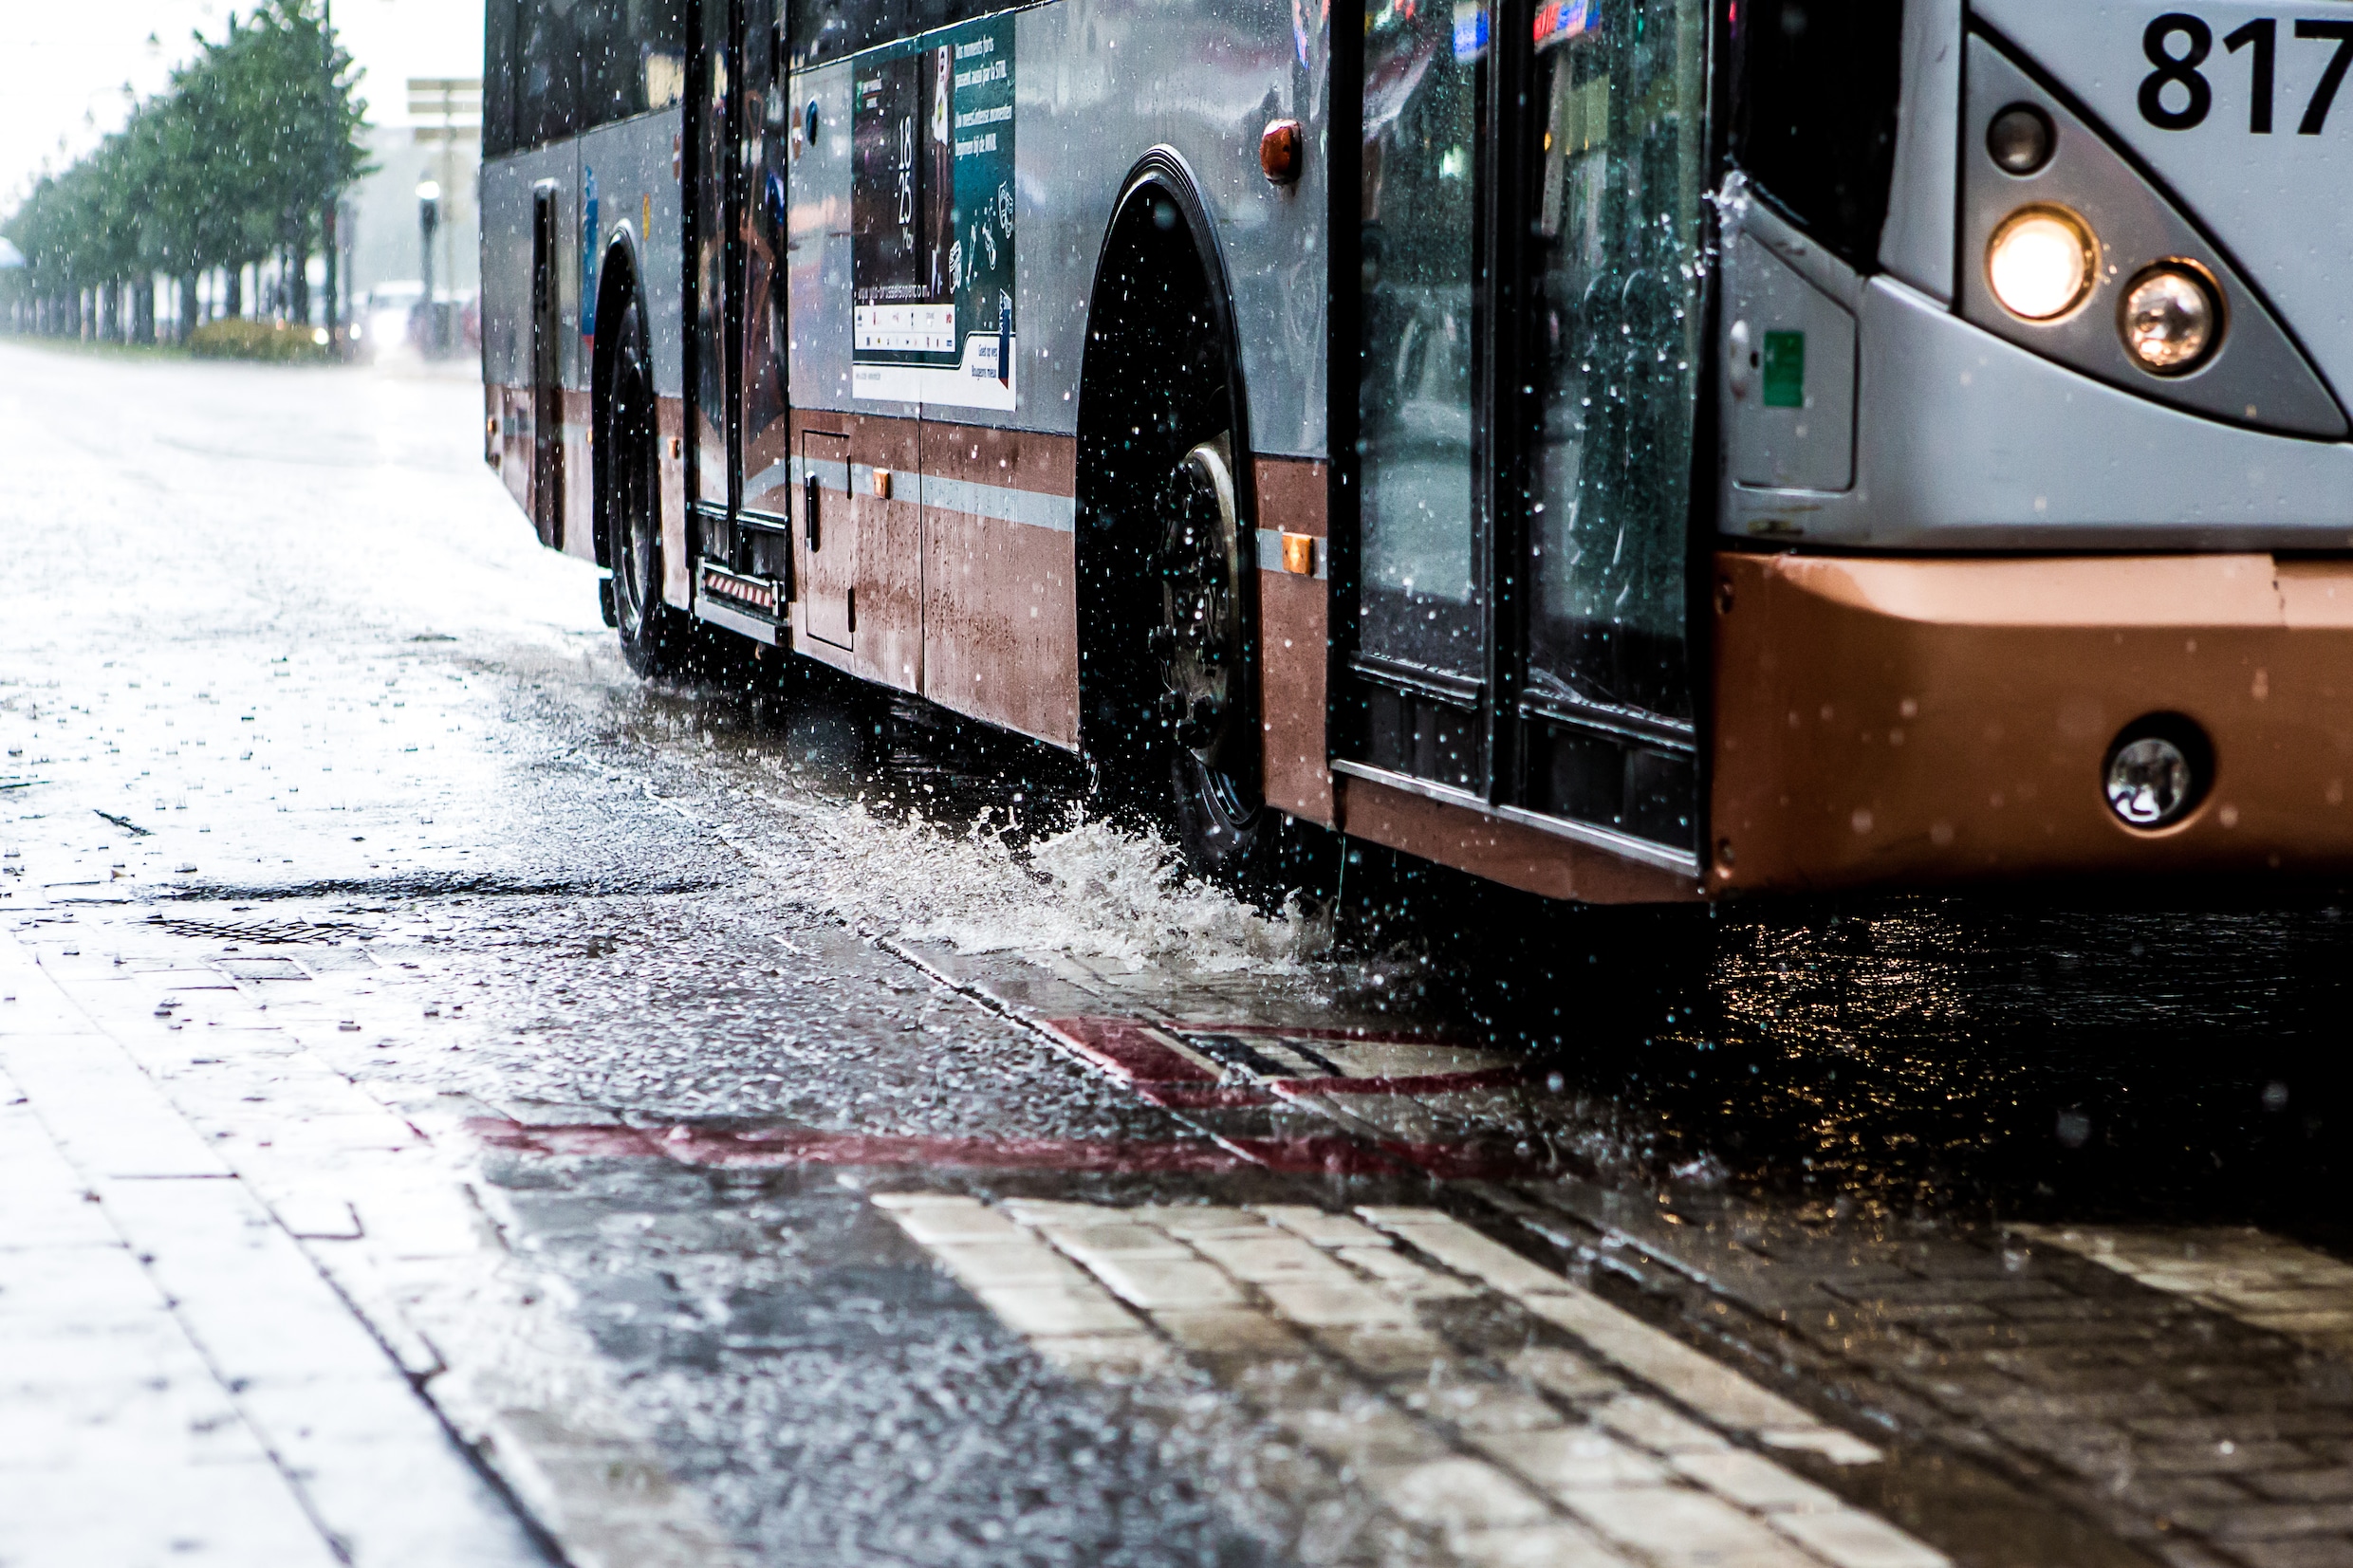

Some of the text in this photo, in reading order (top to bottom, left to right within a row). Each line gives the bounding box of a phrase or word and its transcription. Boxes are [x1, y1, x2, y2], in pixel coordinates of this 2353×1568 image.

[2138, 12, 2353, 135] 817
[899, 115, 912, 171] 18
[899, 171, 912, 225] 25
